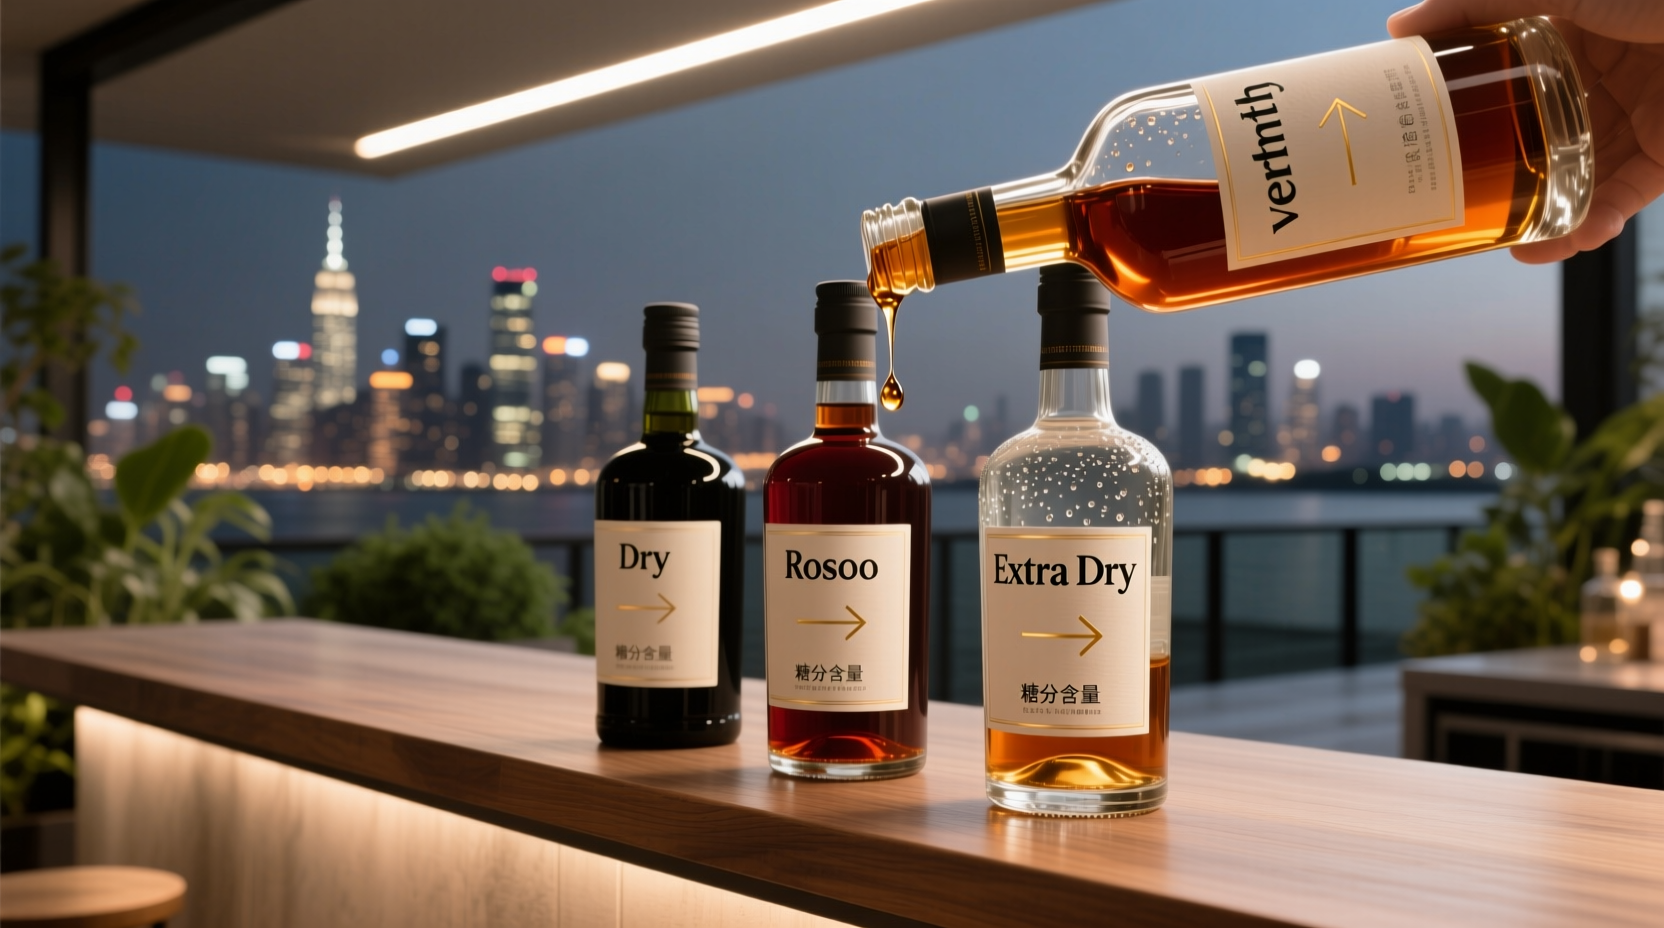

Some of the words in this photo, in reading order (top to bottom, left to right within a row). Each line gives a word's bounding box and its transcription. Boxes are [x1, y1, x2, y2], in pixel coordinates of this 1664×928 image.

[619, 543, 670, 579] Dry
[785, 549, 878, 580] Rosoo
[993, 553, 1070, 587] Extra
[1076, 555, 1137, 595] Dry
[794, 662, 864, 682] 糖分含量
[1020, 682, 1101, 704] 糖分含量
